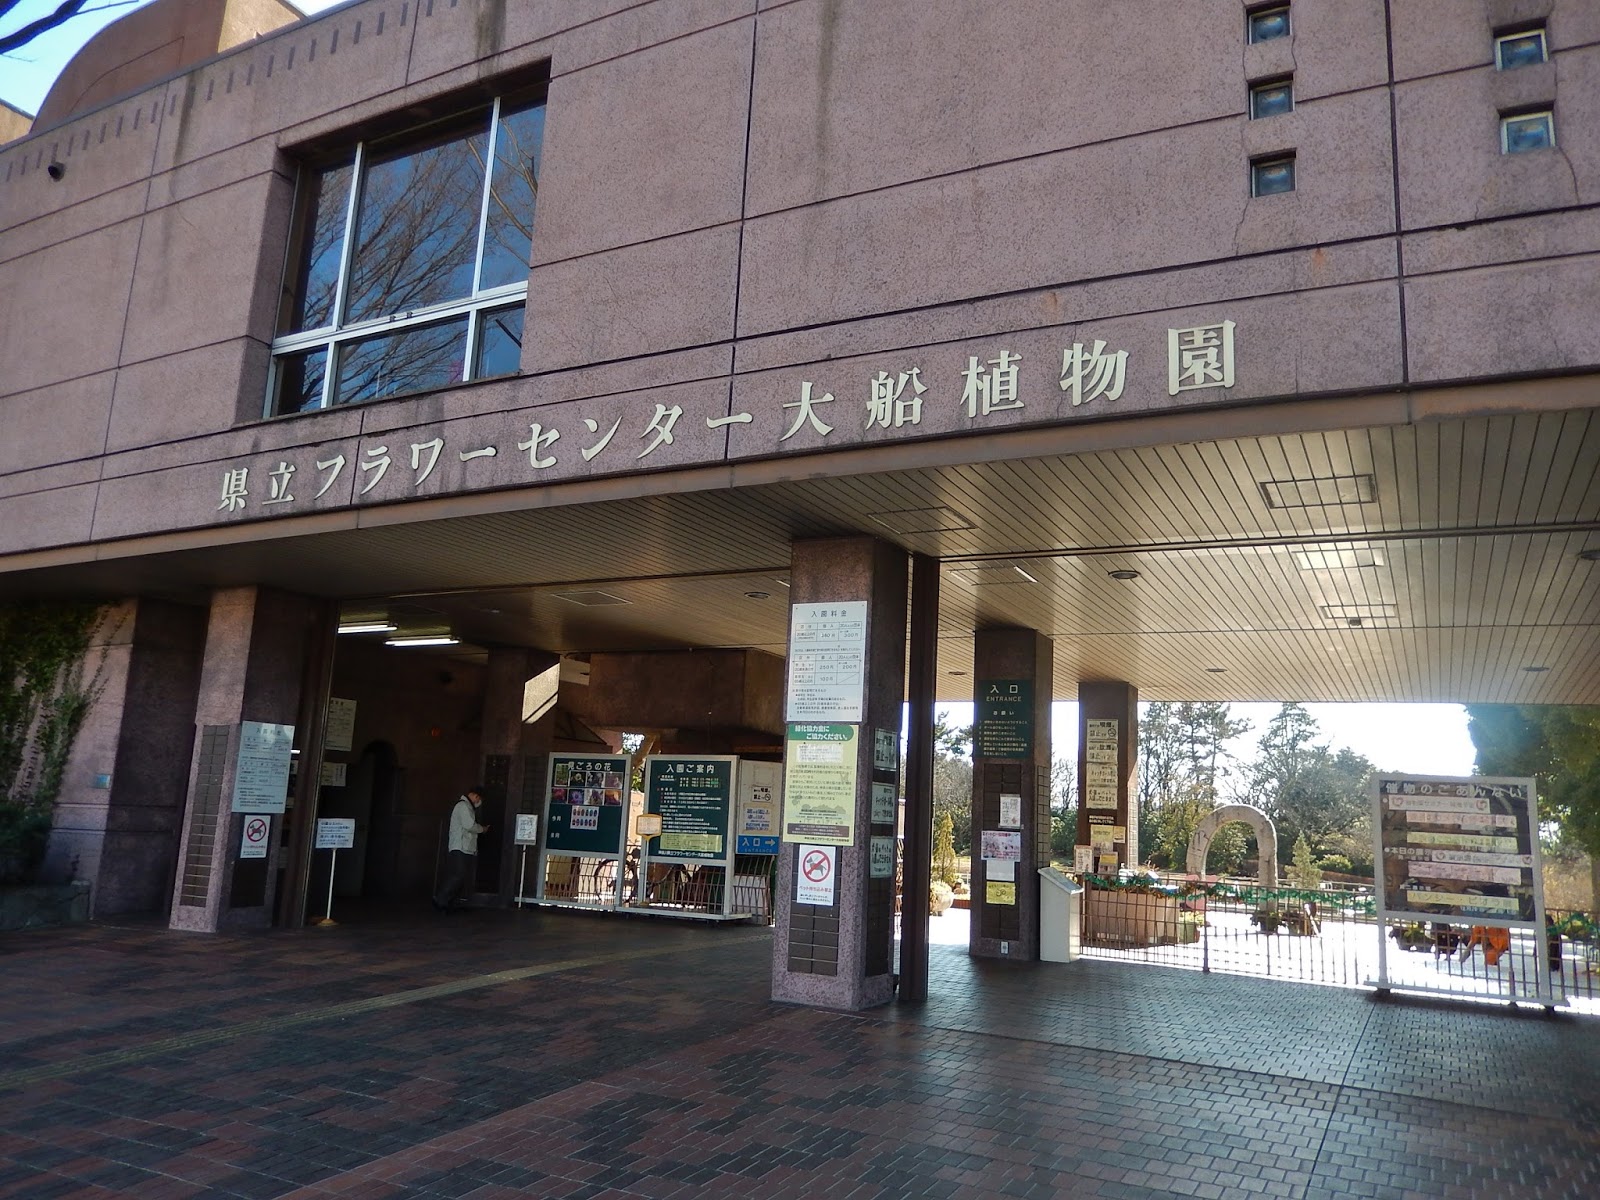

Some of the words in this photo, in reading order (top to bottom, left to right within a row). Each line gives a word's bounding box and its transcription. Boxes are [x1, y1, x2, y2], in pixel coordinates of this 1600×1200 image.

[217, 319, 1237, 513] 県立フラワーセンター大船植物園
[811, 609, 847, 618] 入園料金
[990, 684, 1018, 694] 入口
[806, 733, 848, 741] ご協力ください。
[568, 761, 611, 771] 見ごろの花
[666, 763, 715, 774] 入園ご案内
[1386, 783, 1522, 798] 催物のごあんない
[742, 837, 761, 847] 入口
